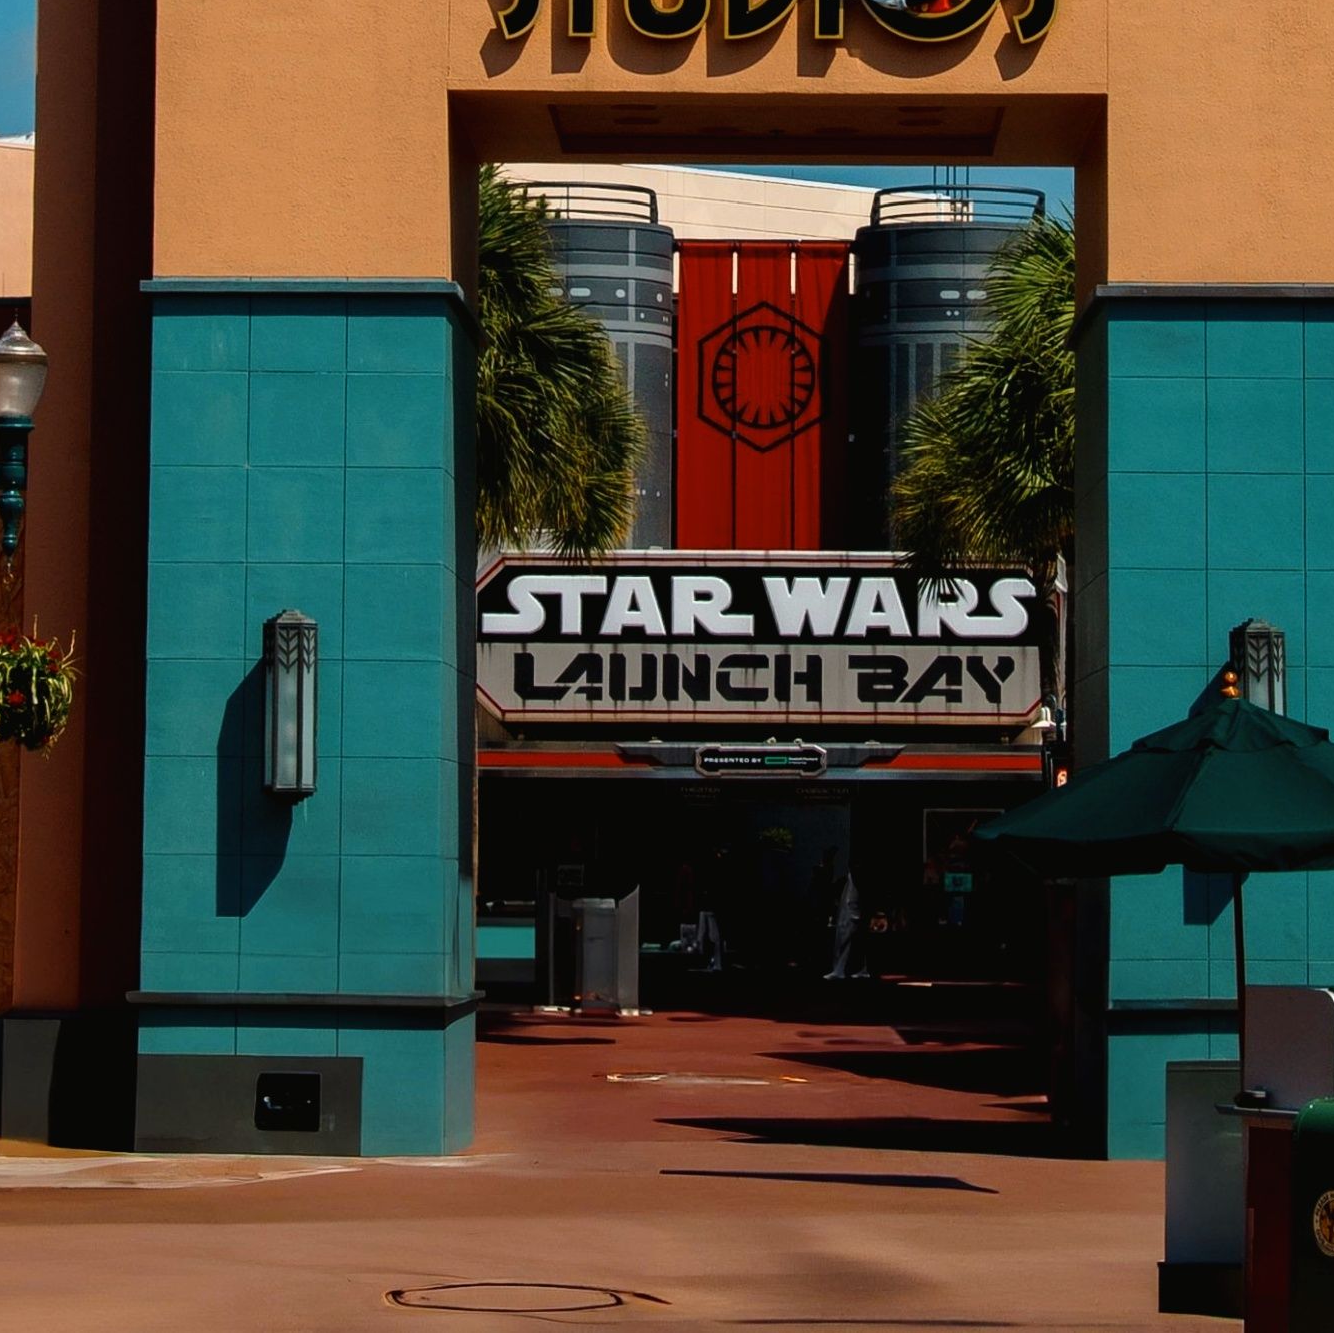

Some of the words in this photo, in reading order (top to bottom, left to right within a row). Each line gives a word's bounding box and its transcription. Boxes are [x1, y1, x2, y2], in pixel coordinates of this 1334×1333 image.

[481, 574, 755, 637] STAR
[762, 576, 1037, 639] WARS
[513, 651, 823, 702] LAUNCH
[847, 653, 1016, 704] BAY
